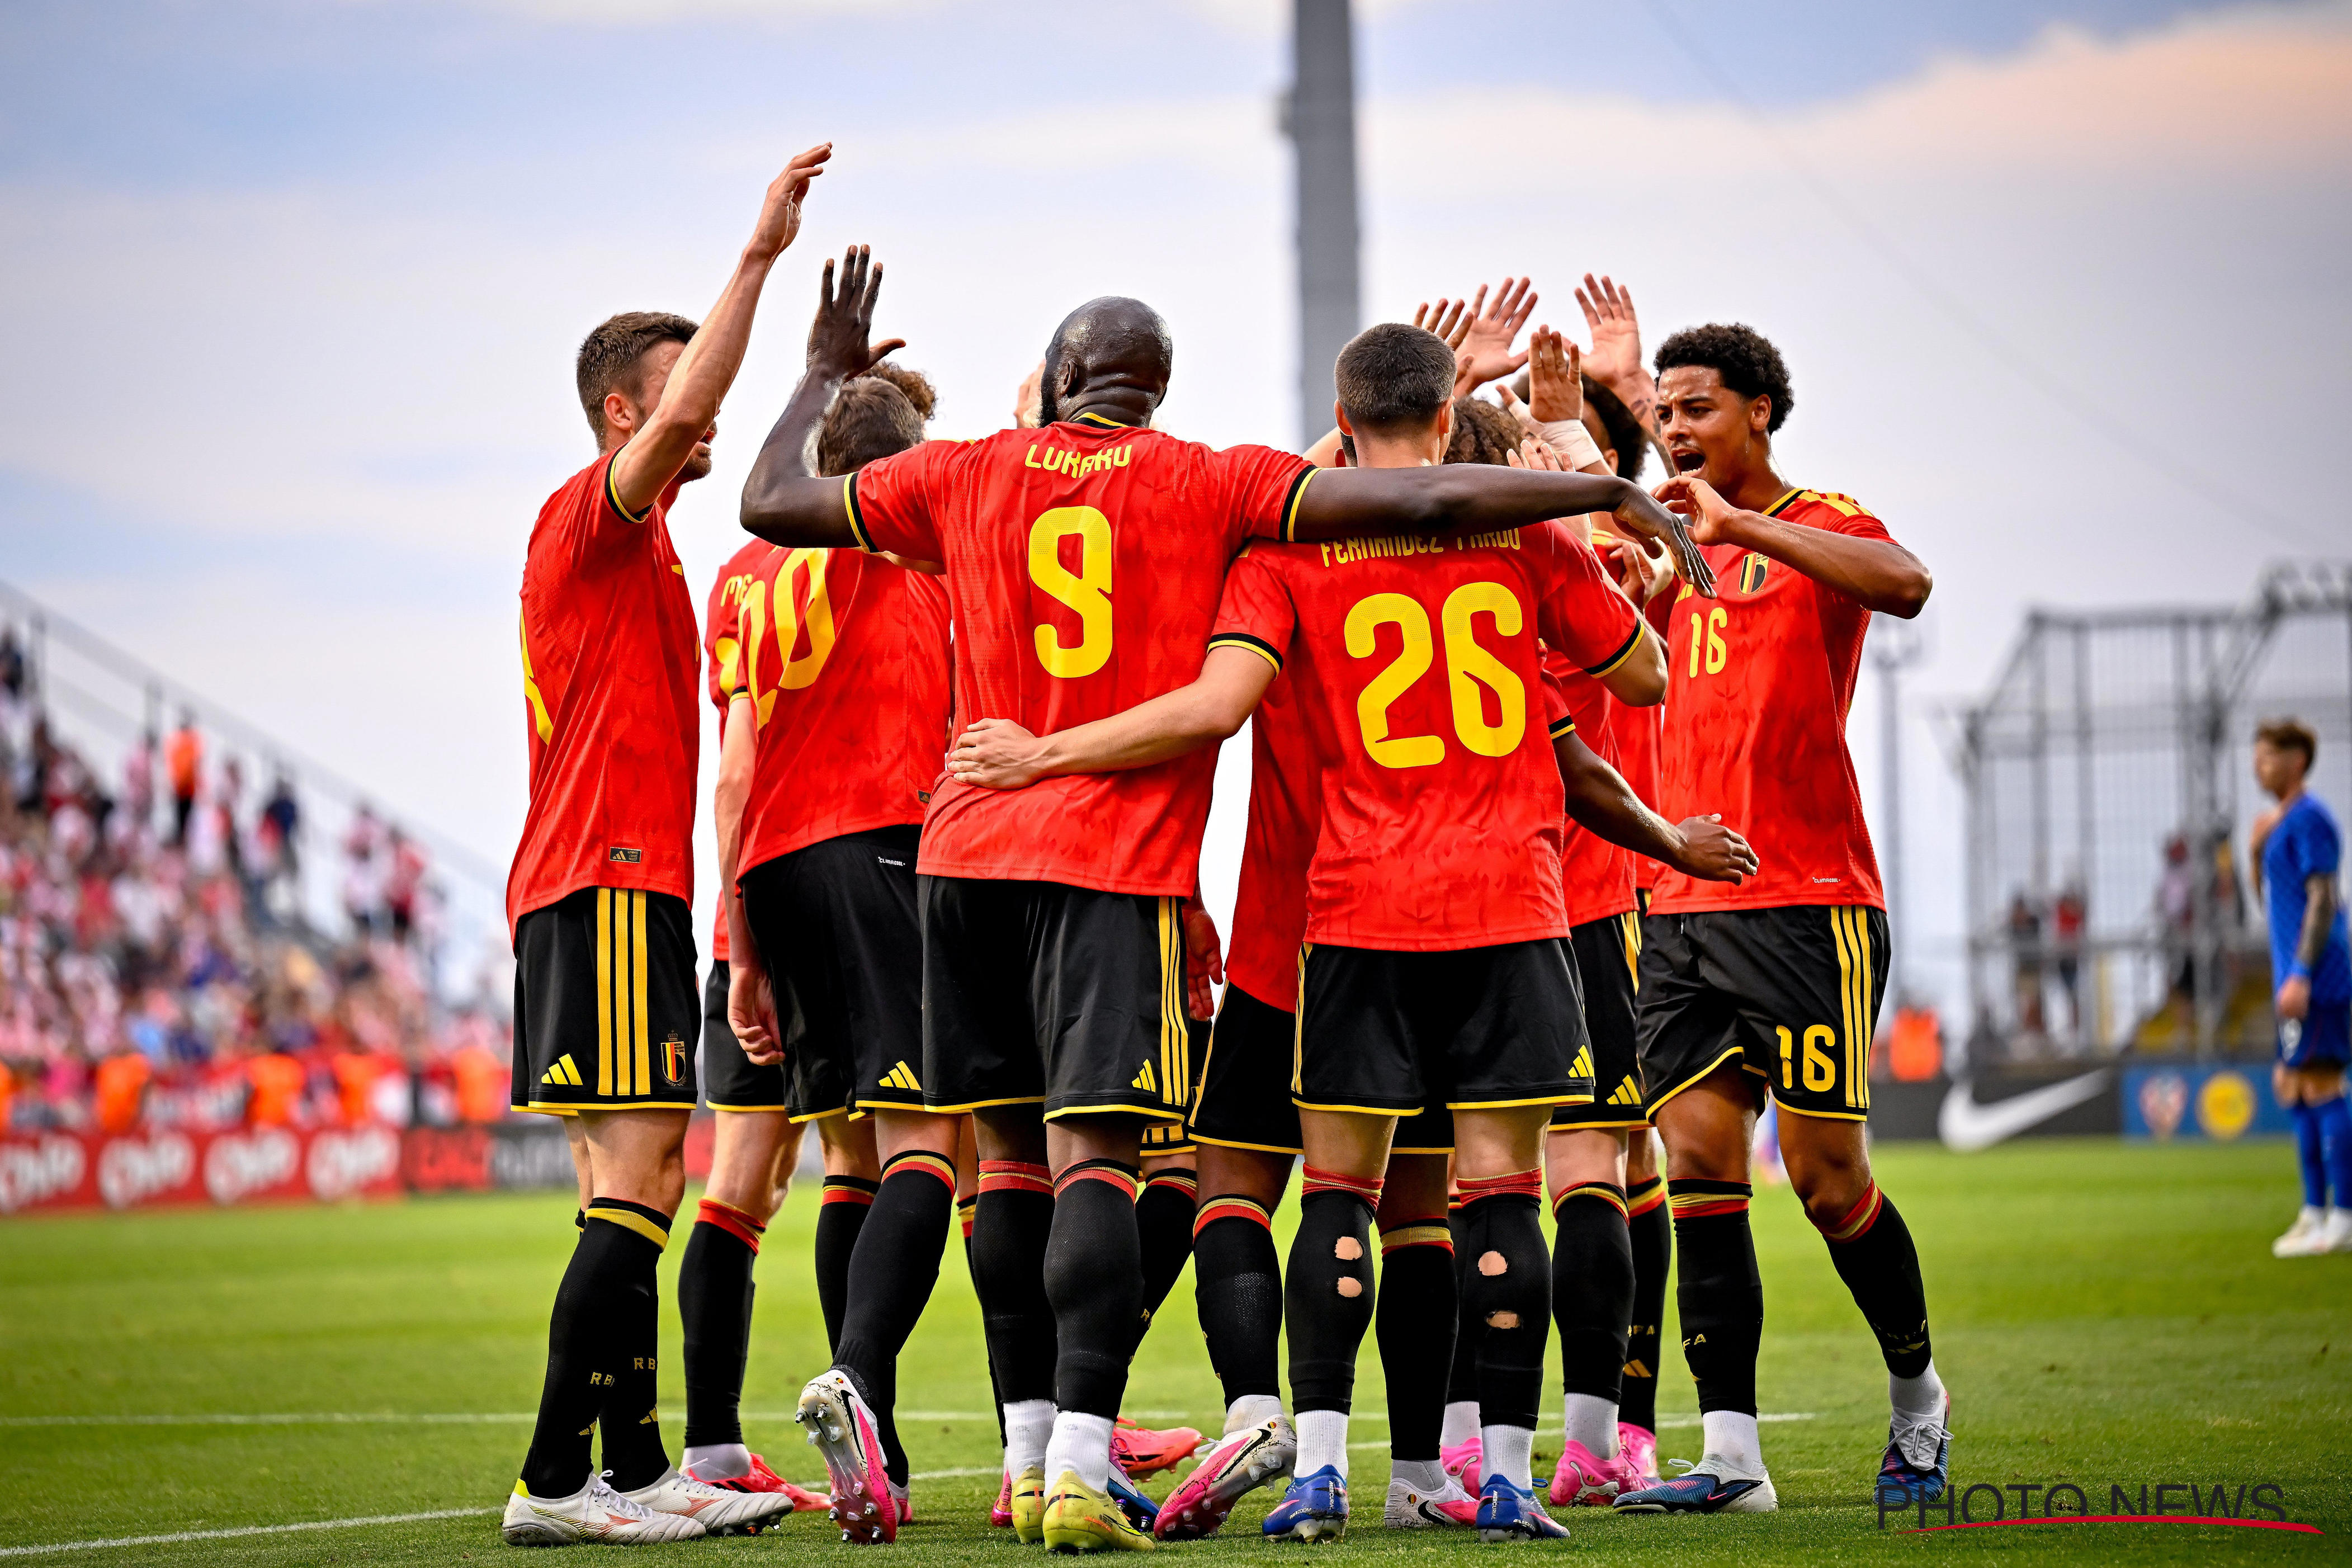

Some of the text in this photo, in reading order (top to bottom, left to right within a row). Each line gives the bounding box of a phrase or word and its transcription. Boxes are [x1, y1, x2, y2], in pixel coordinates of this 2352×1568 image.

[1025, 445, 1132, 478] LUKAKU
[1028, 506, 1113, 678] 9
[1344, 582, 1526, 768] 26
[1689, 607, 1727, 678] 16
[1775, 1024, 1836, 1092] 16
